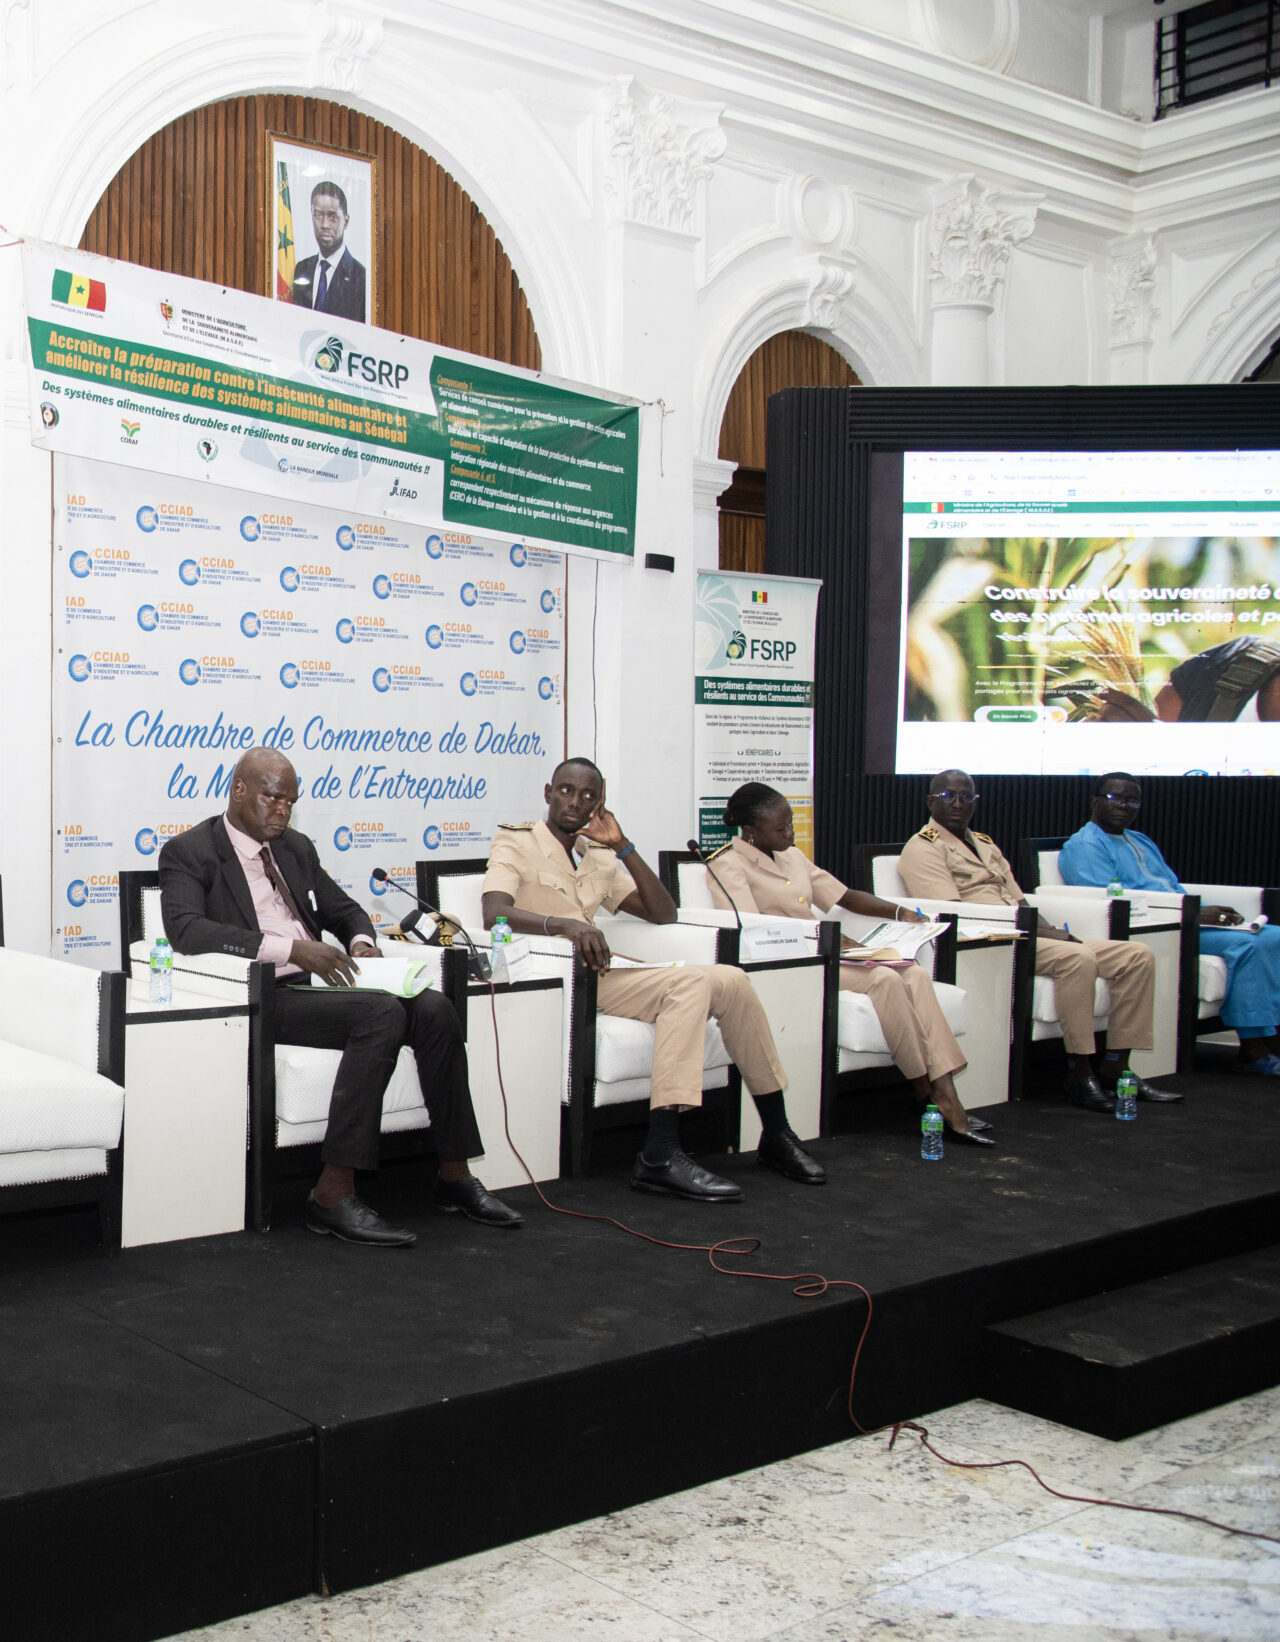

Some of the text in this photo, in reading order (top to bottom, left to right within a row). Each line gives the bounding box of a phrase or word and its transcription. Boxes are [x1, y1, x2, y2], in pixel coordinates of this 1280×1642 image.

[347, 351, 409, 389] FSRP
[49, 330, 110, 359] Accroître
[114, 346, 127, 363] la
[130, 352, 210, 381] préparation
[214, 371, 254, 390] contre
[257, 379, 324, 407] l'insécurité
[327, 397, 393, 425] alimentaire
[396, 414, 408, 428] et
[46, 350, 406, 443] améliorer la résilience des systèmes alimentaires au Sénégal
[42, 380, 430, 475] Des systèmes alimentaires durables et résilients au service des communautés !!
[120, 436, 138, 445] CORAF
[399, 488, 417, 499] IFAD
[161, 504, 194, 516] CCIAD
[262, 514, 293, 526] CCIAD
[357, 524, 385, 535] CCIAD
[445, 533, 471, 544] CCIAD
[95, 549, 130, 560] CCIAD
[301, 565, 331, 576] CCIAD
[393, 572, 421, 583] CCIAD
[479, 580, 505, 591] CCIAD
[262, 610, 293, 621] CCIAD
[527, 629, 548, 639] CCIAD
[750, 639, 796, 661] FSRP
[94, 651, 130, 662] CCIAD
[703, 679, 805, 692] Des systèmes alimentaires durables
[703, 690, 728, 699] résilients
[737, 693, 757, 701] service
[757, 692, 767, 701] des
[768, 692, 805, 702] Communautés
[75, 710, 546, 758] La Chambre de Commerce de Dakar,
[167, 763, 199, 799] la
[311, 765, 342, 799] de
[350, 764, 487, 809] l'Entreprise
[354, 823, 383, 832] CCIAD
[443, 822, 470, 832] CCIAD
